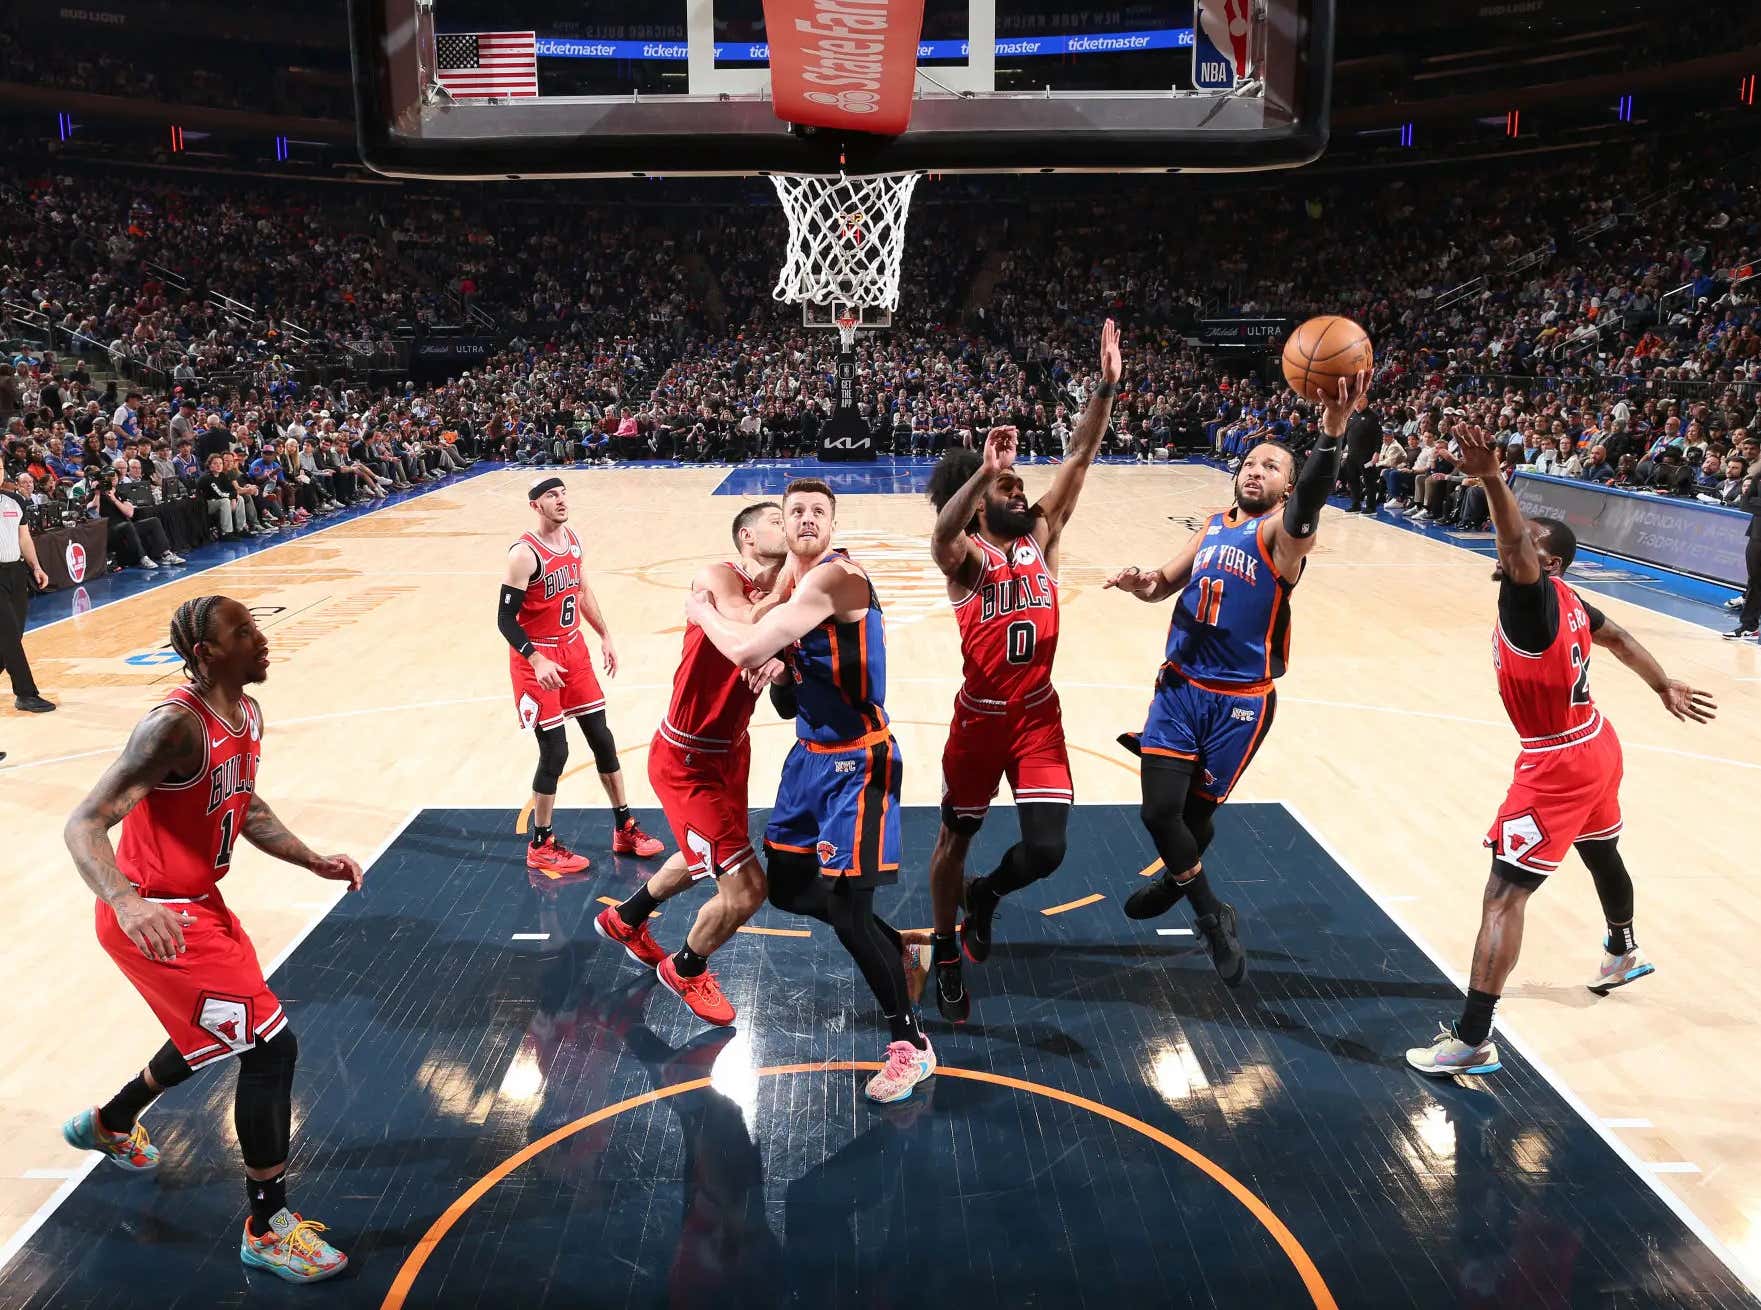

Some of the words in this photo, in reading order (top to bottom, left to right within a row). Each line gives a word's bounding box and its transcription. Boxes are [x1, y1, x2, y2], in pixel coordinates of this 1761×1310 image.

[536, 41, 616, 56] ticketmaster
[1068, 35, 1150, 51] ticketmaster
[1200, 62, 1227, 82] NBA
[1247, 325, 1281, 336] ULTRA
[456, 345, 484, 353] ULTRA
[841, 380, 852, 389] GET
[841, 390, 852, 398] THE
[841, 399, 852, 408] APP
[1632, 509, 1693, 532] MONDAY
[1218, 545, 1258, 587] YORK
[980, 574, 1052, 624] BULLS
[1194, 576, 1224, 627] 11
[560, 594, 576, 628] 6
[1006, 620, 1037, 665] 0
[215, 808, 235, 869] 1
